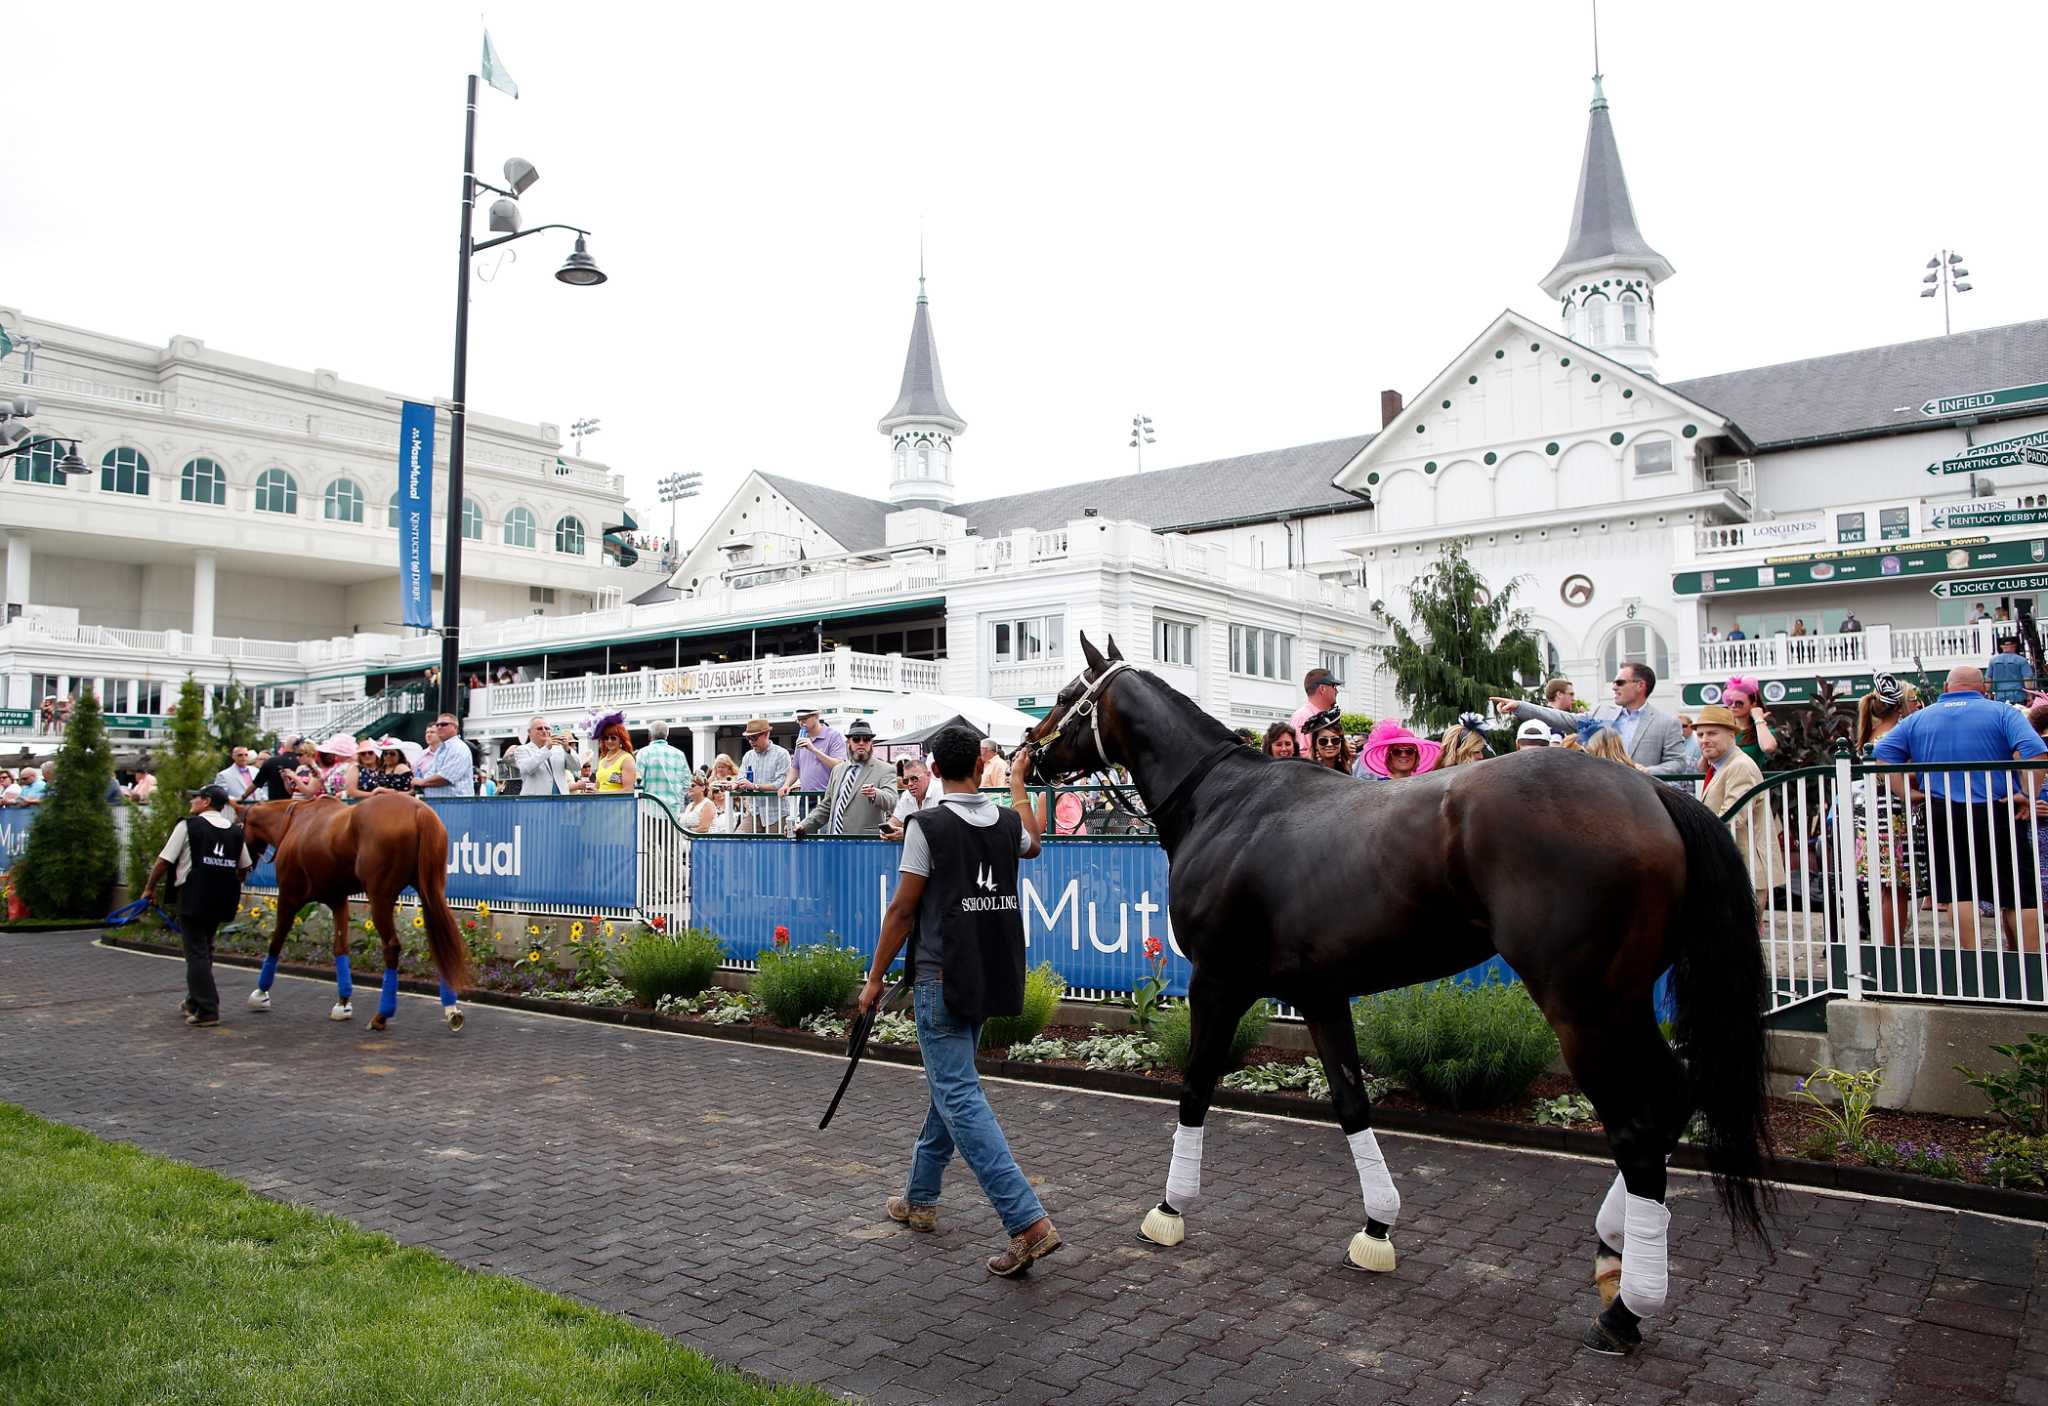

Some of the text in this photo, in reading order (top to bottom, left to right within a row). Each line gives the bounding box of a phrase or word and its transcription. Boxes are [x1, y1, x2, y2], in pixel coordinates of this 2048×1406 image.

[1941, 394, 1995, 412] INFIELD
[1945, 456, 1998, 472] STARTING
[1932, 501, 2006, 516] LONGINES
[409, 439, 422, 601] MassMutual KENTUCKY DERBY
[1851, 516, 1862, 528] 2
[1950, 515, 2002, 526] KENTUCKY
[2004, 512, 2035, 522] DERBY
[1753, 521, 1817, 537] LONGINES
[1840, 530, 1862, 542] RACE
[1895, 541, 1948, 552] CHURCHILL
[1950, 536, 1986, 546] DOWNS
[1952, 582, 1996, 593] JOCKEY
[1997, 580, 2028, 590] CLUB
[697, 672, 728, 690] 50/50
[729, 667, 762, 686] RAFFE
[961, 895, 1018, 912] SCHOOLING
